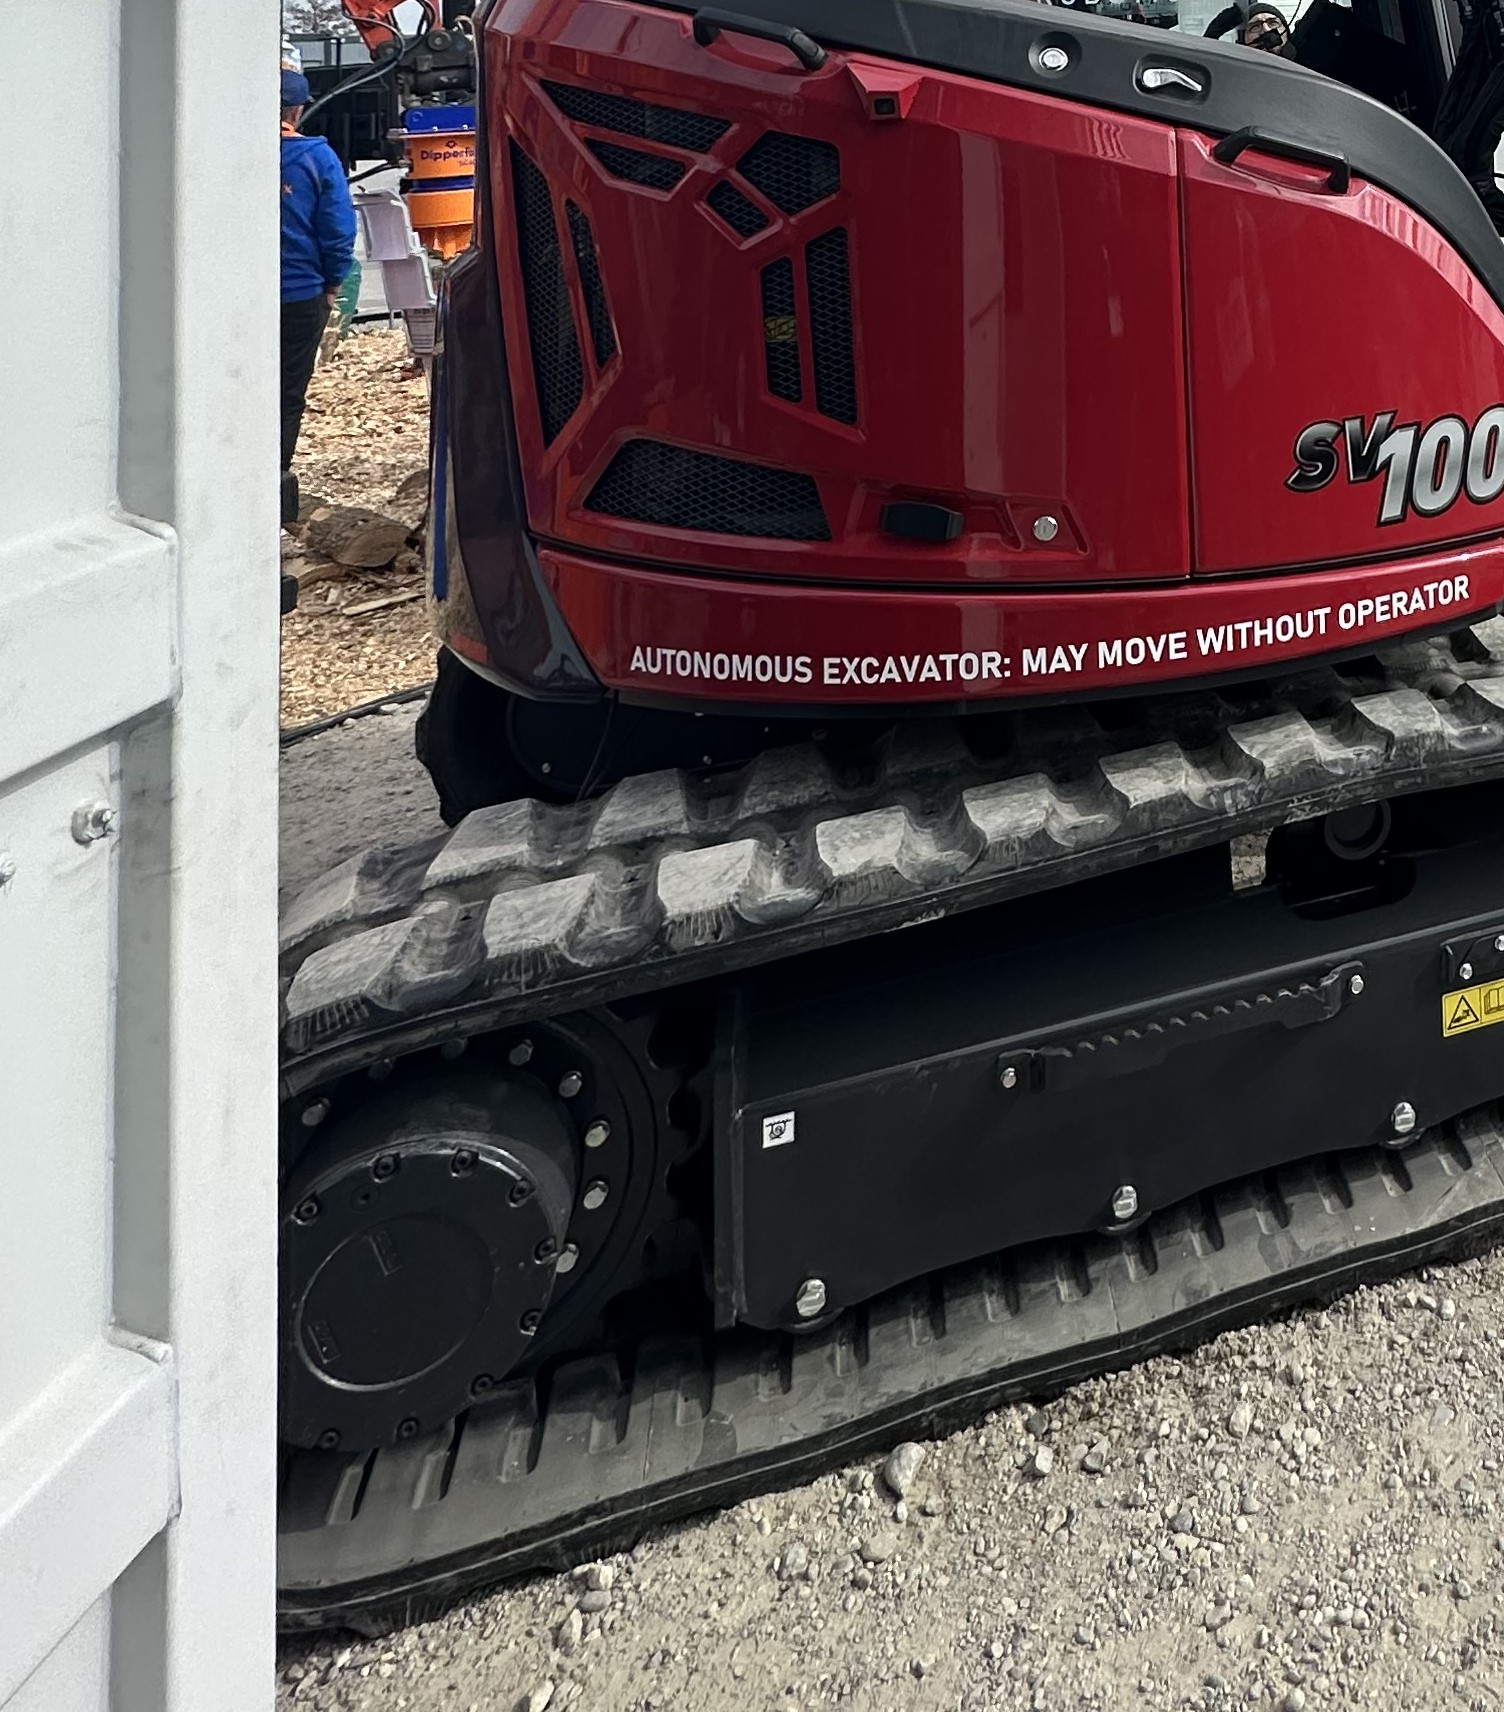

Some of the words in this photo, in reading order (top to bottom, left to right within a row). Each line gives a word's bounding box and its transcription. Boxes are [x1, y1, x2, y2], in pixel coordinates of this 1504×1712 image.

[420, 147, 475, 162] Dipperfo
[630, 645, 813, 684] AUTONOMOUS
[823, 651, 1011, 684] EXCAVATOR:
[1021, 642, 1089, 679] MAY
[1096, 633, 1188, 669] MOVE
[1196, 607, 1331, 655] WITHOUT
[1338, 575, 1469, 630] OPERATOR
